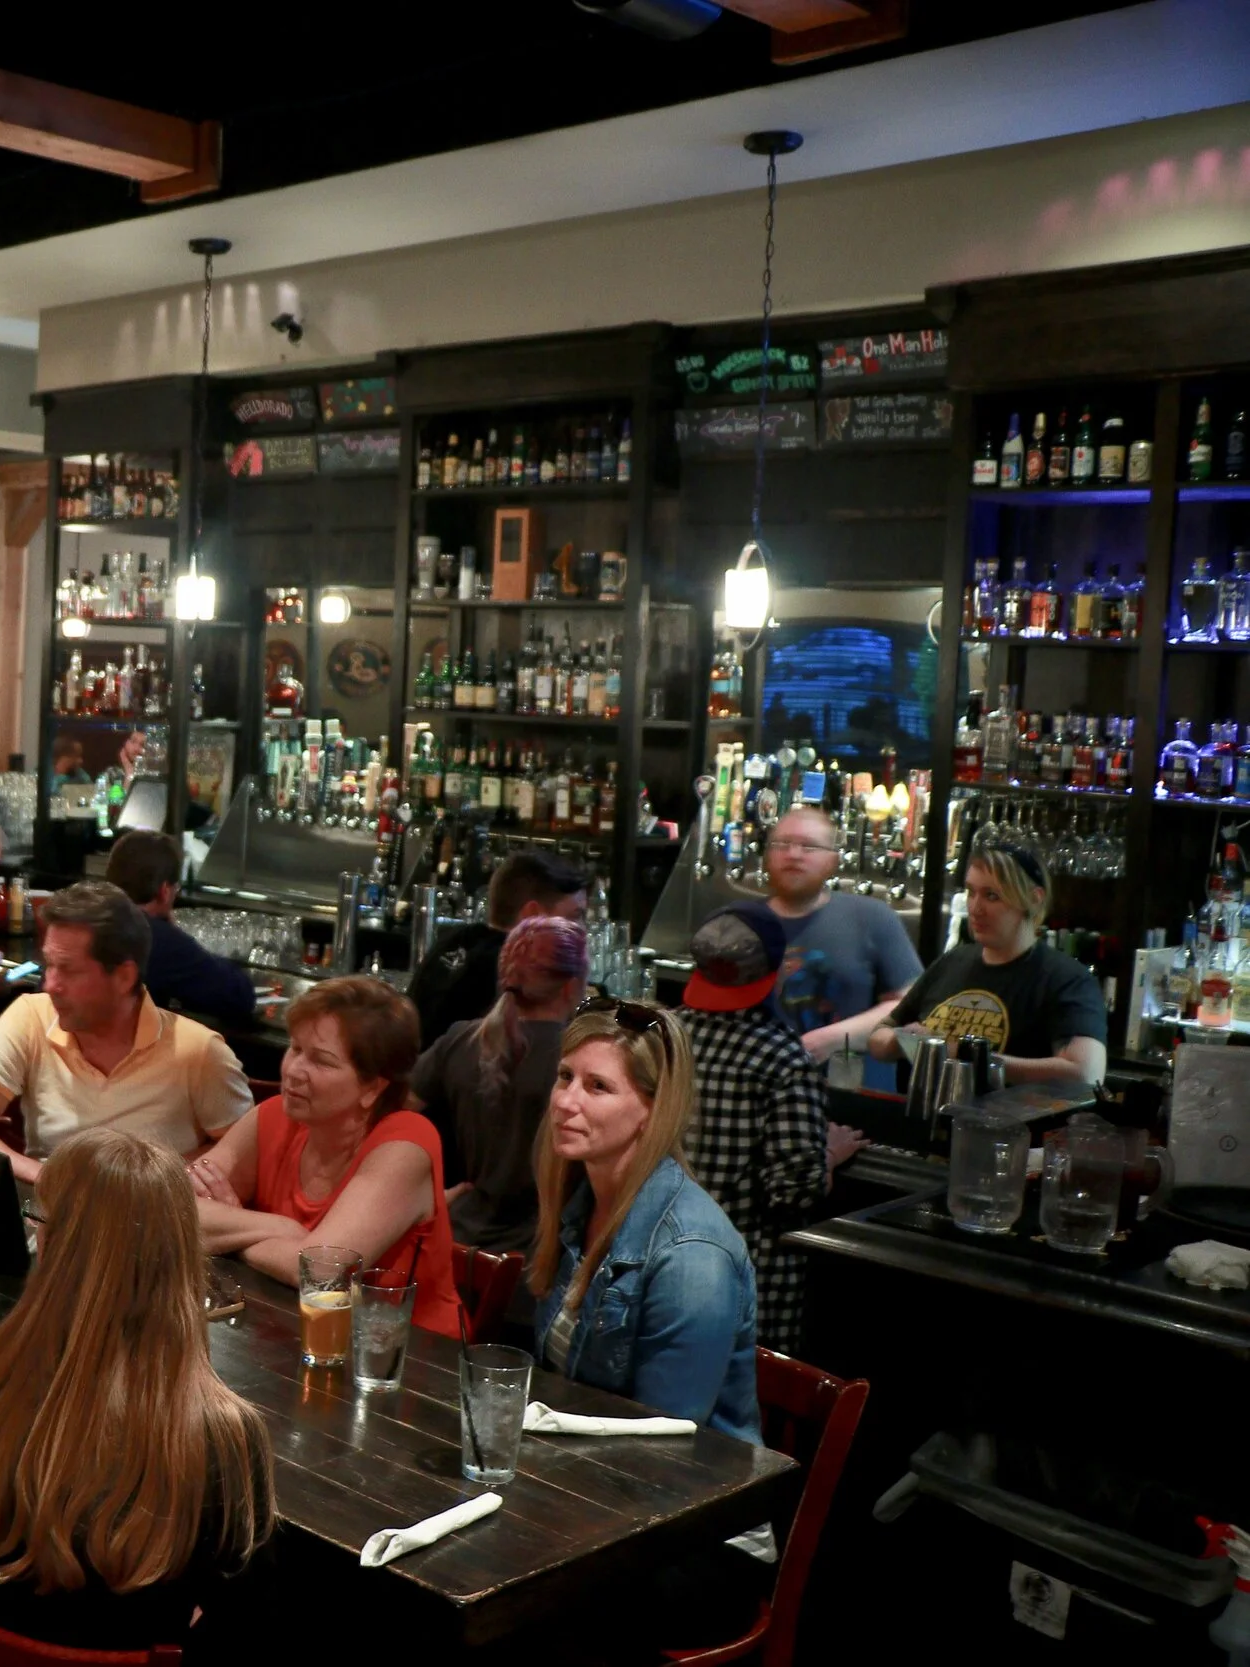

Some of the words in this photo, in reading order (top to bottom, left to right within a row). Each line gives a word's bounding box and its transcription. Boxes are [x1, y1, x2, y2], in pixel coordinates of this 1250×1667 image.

[862, 336, 888, 358] One
[889, 332, 921, 355] Man
[235, 399, 293, 424] HELLDORADO
[934, 1003, 1003, 1028] NORTH
[925, 1016, 1003, 1041] TEXAS
